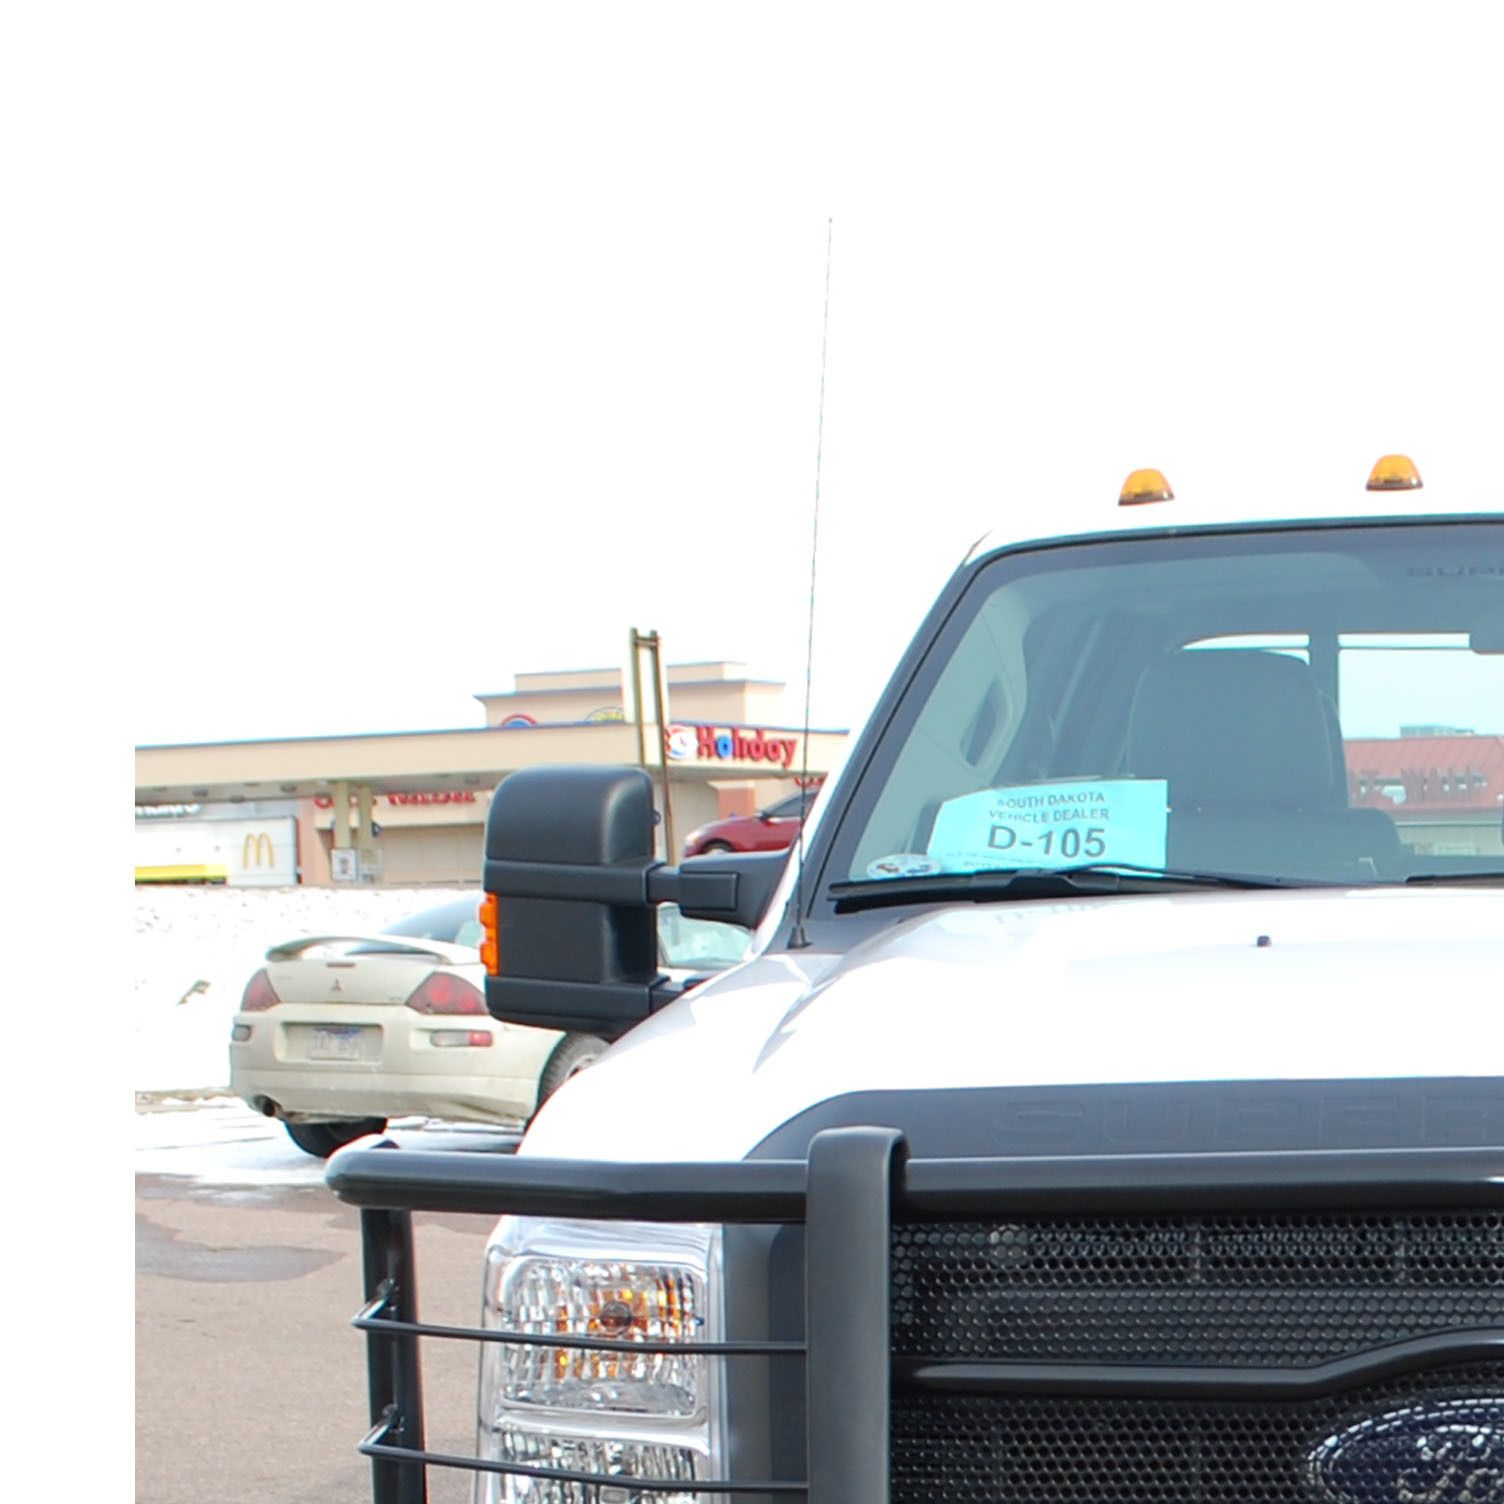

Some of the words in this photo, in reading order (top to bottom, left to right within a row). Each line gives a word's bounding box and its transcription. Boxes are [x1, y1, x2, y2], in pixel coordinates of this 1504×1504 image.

[696, 725, 798, 768] Holiday
[1047, 791, 1106, 807] DAKOTA
[1053, 808, 1110, 823] DEALER
[987, 824, 1107, 859] D-105
